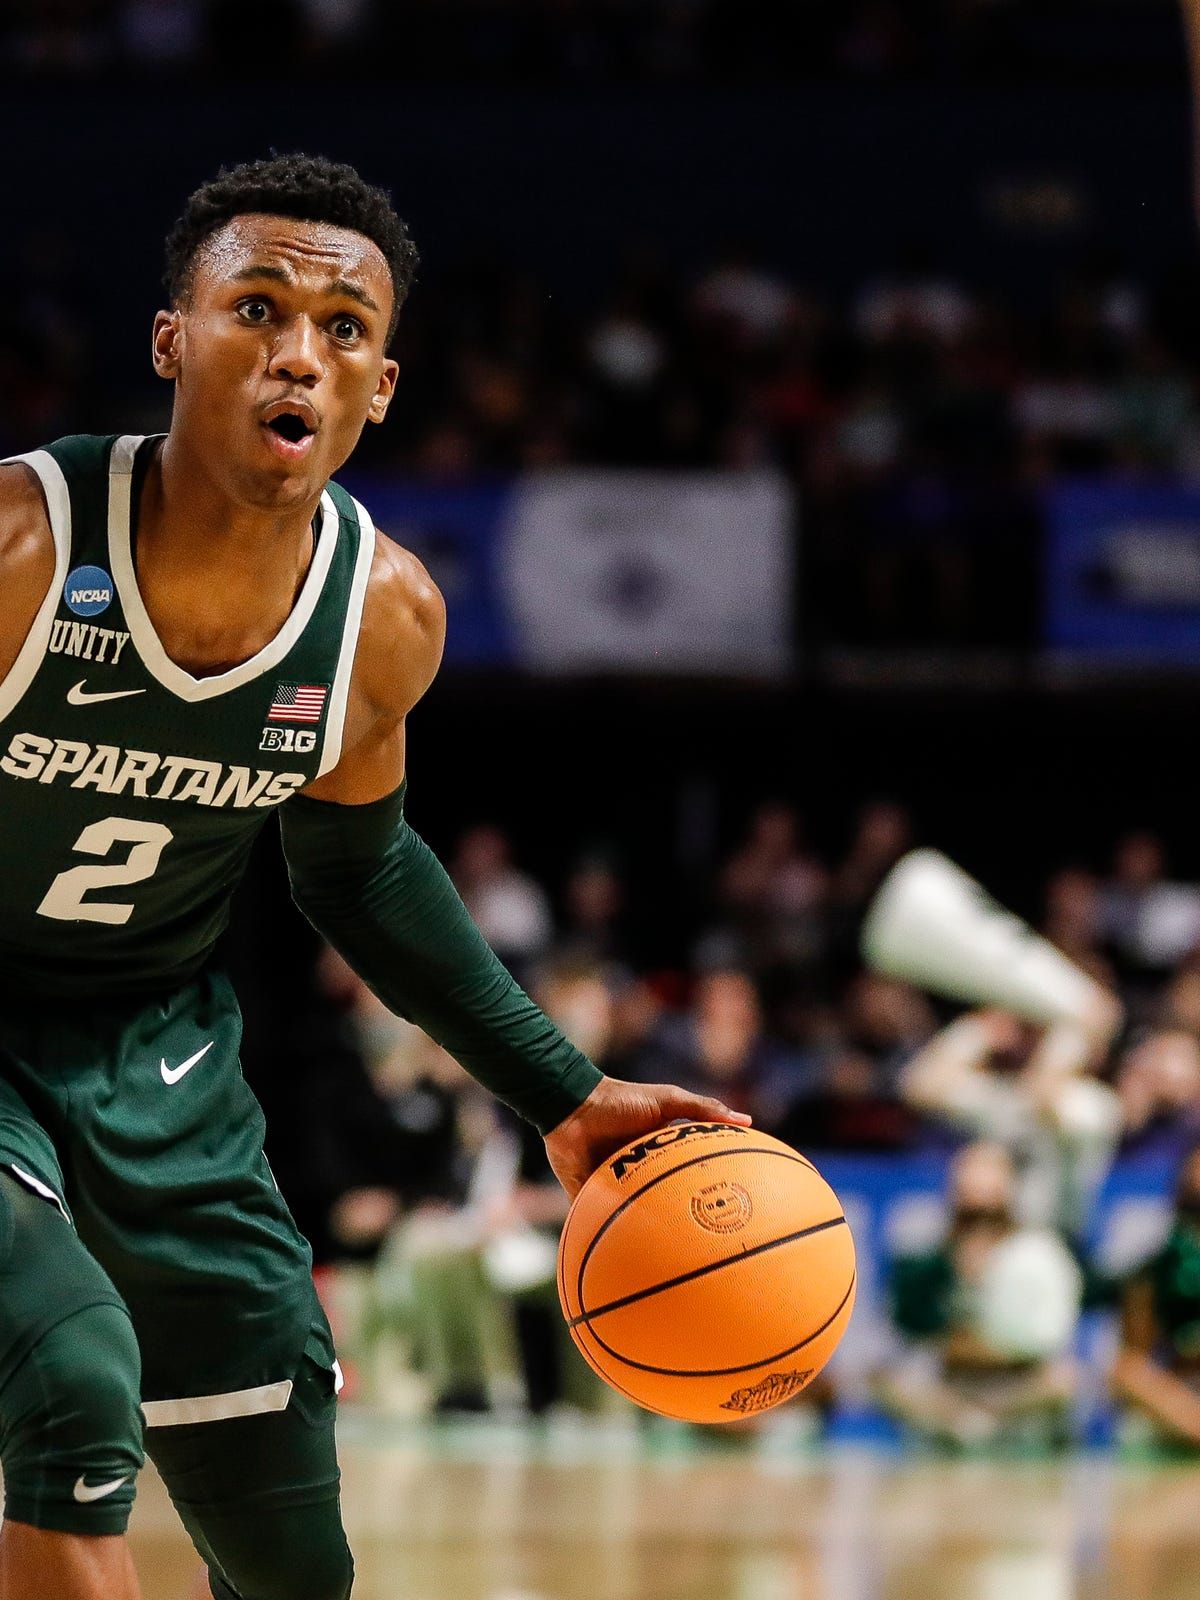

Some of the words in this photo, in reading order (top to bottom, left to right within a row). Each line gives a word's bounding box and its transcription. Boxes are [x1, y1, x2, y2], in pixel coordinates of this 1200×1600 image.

[70, 588, 111, 605] NCAA
[49, 619, 130, 665] UNITY
[0, 732, 306, 809] SPARTANS
[35, 816, 174, 925] 2
[610, 1124, 748, 1180] NCAA
